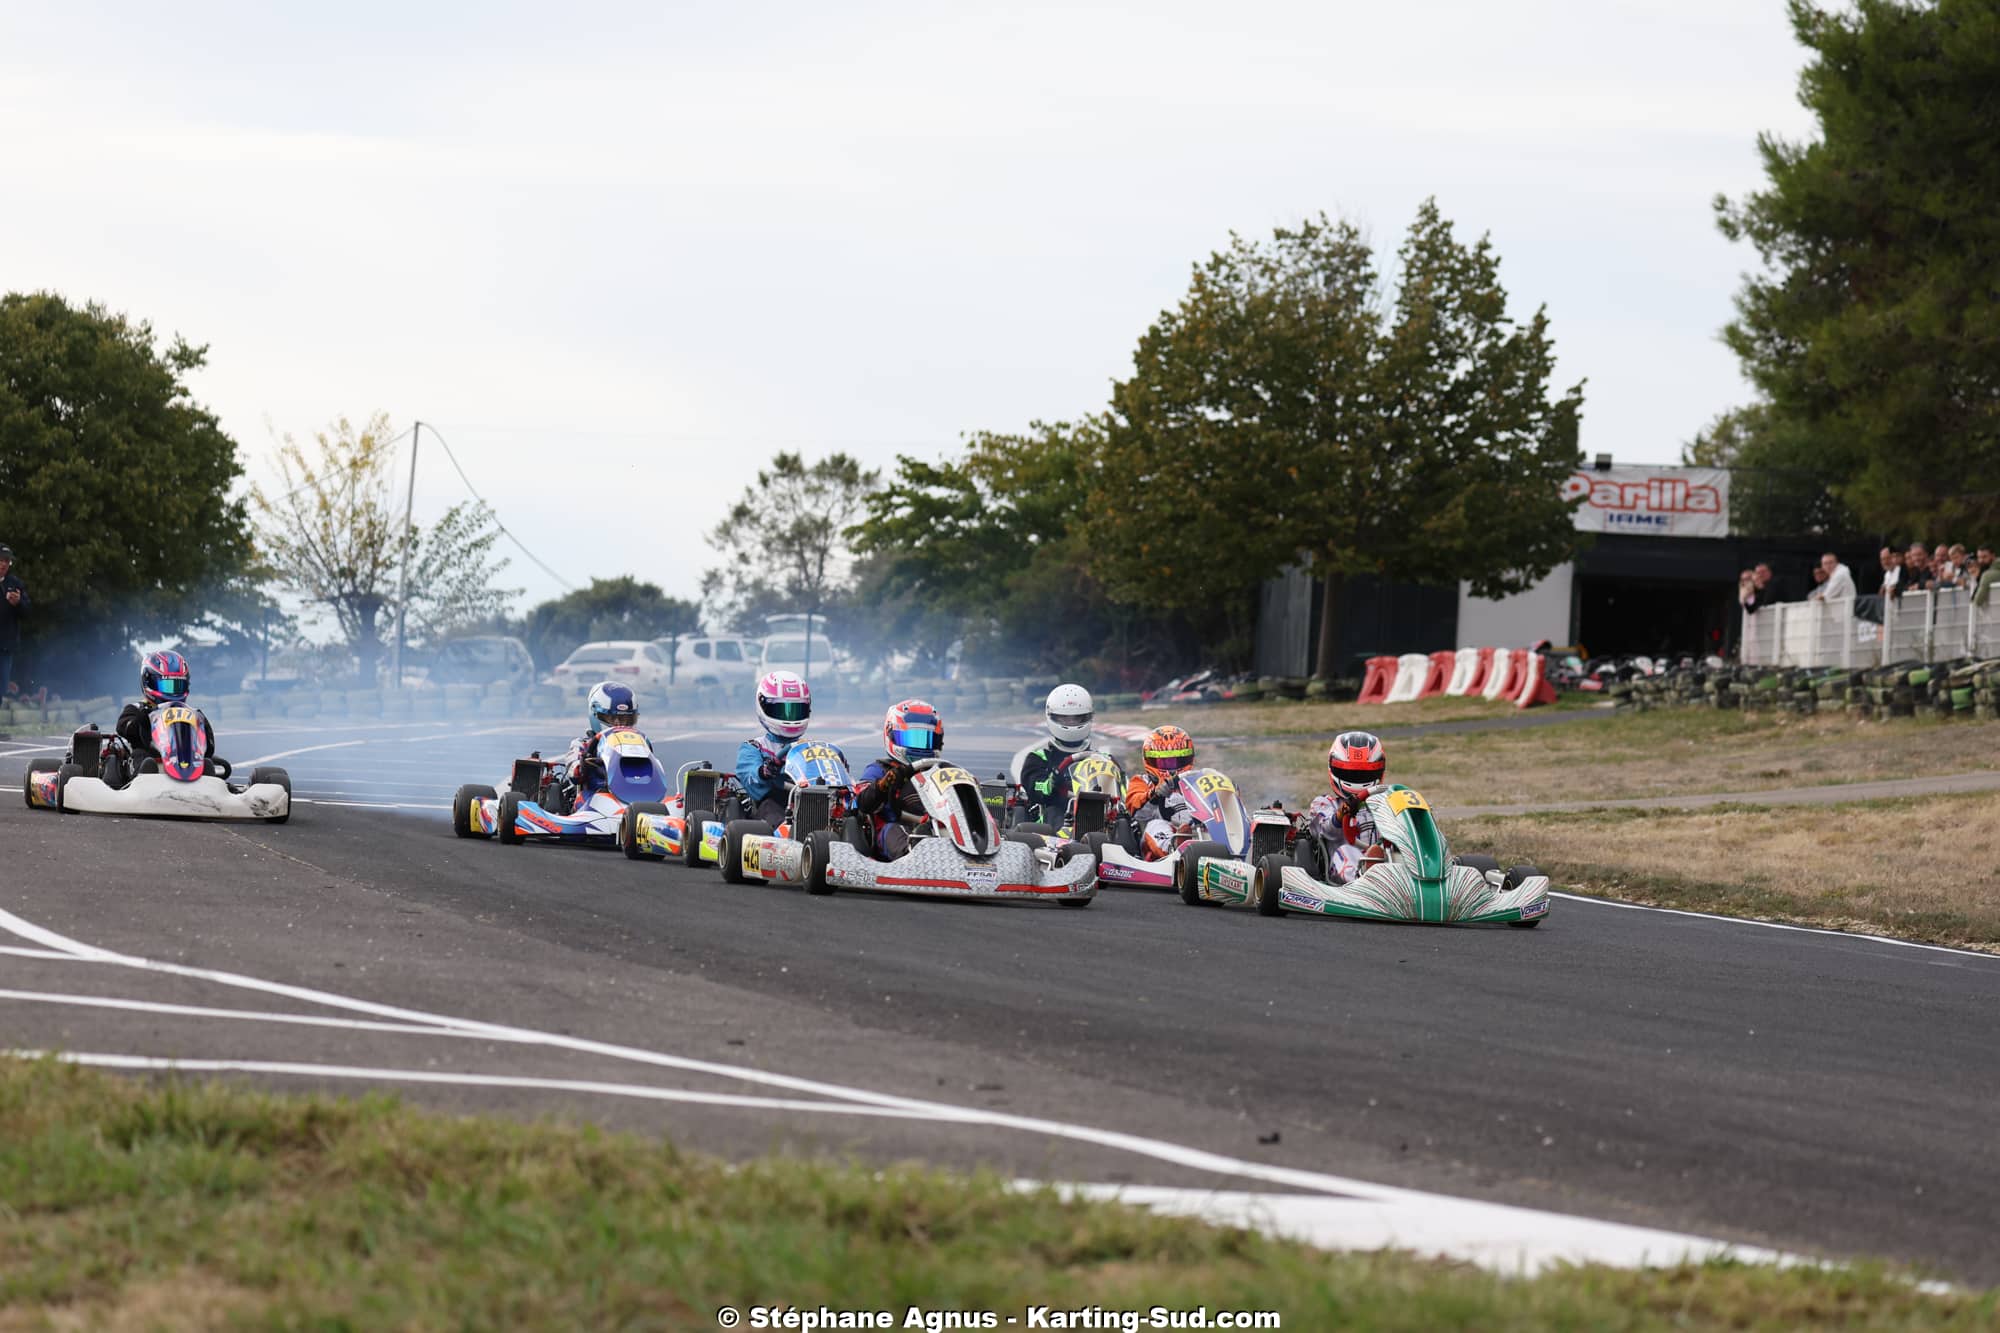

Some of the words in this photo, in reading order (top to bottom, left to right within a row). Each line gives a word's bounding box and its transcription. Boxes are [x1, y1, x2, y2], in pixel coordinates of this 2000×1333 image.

[1558, 474, 1721, 513] Parilla
[1609, 513, 1669, 526] IAME
[166, 708, 193, 720] 417
[1199, 775, 1230, 793] 32
[1403, 791, 1420, 806] 3
